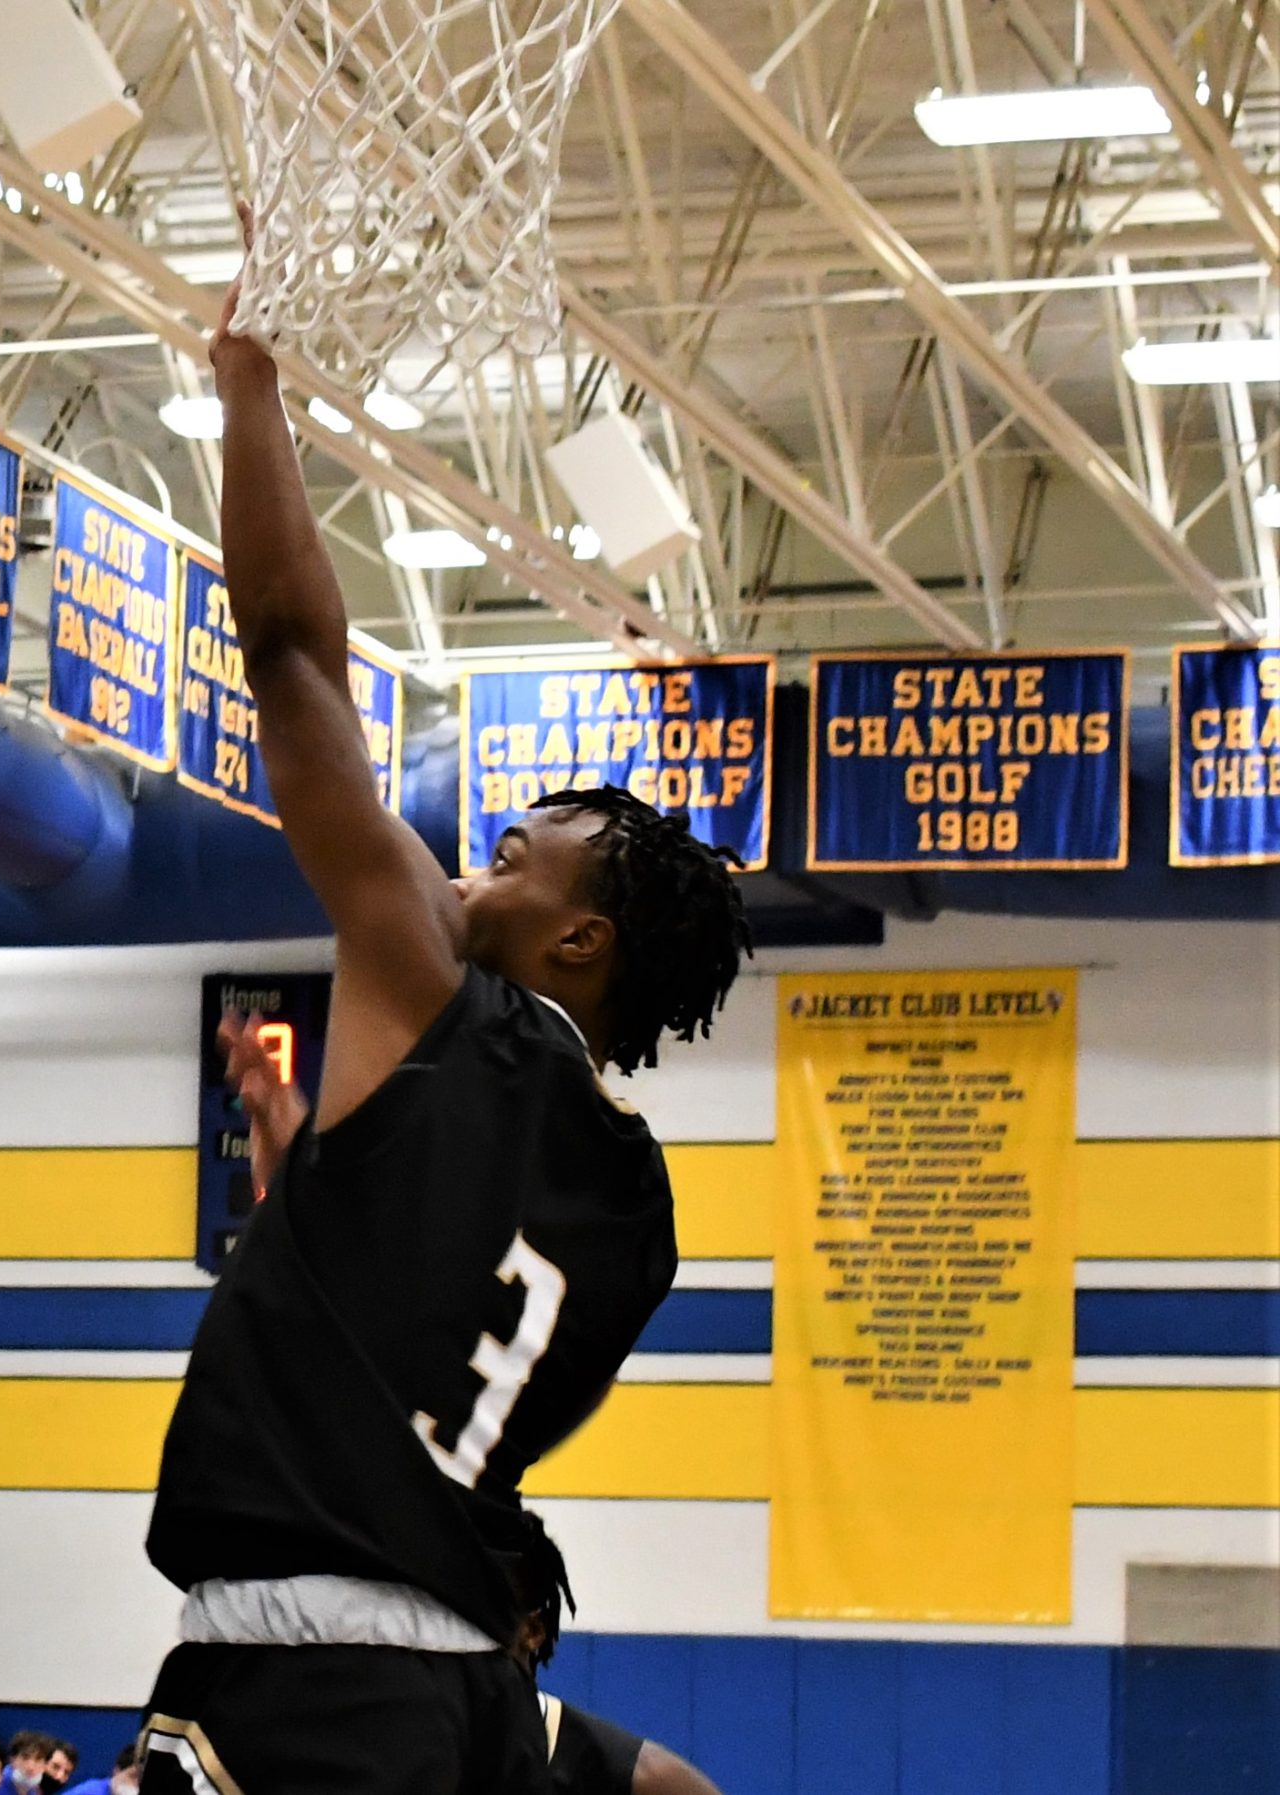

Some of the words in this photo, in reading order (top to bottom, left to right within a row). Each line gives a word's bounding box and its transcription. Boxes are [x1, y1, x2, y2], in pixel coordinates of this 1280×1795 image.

[83, 507, 146, 582] STATE
[53, 547, 165, 645] CHAMPIONS
[56, 601, 158, 696] BASEBALL
[538, 670, 693, 718] STATE
[892, 666, 1045, 710] STATE
[477, 717, 755, 767] CHAMPIONS
[826, 711, 1112, 757] CHAMPIONS
[628, 765, 752, 809] GOLF
[904, 761, 1032, 805] GOLF
[916, 810, 1020, 852] 1988
[221, 983, 282, 1013] Home
[805, 993, 891, 1018] JACKET
[900, 992, 961, 1017] CLUB
[970, 991, 1043, 1017] LEVEL
[410, 1226, 567, 1491] 3
